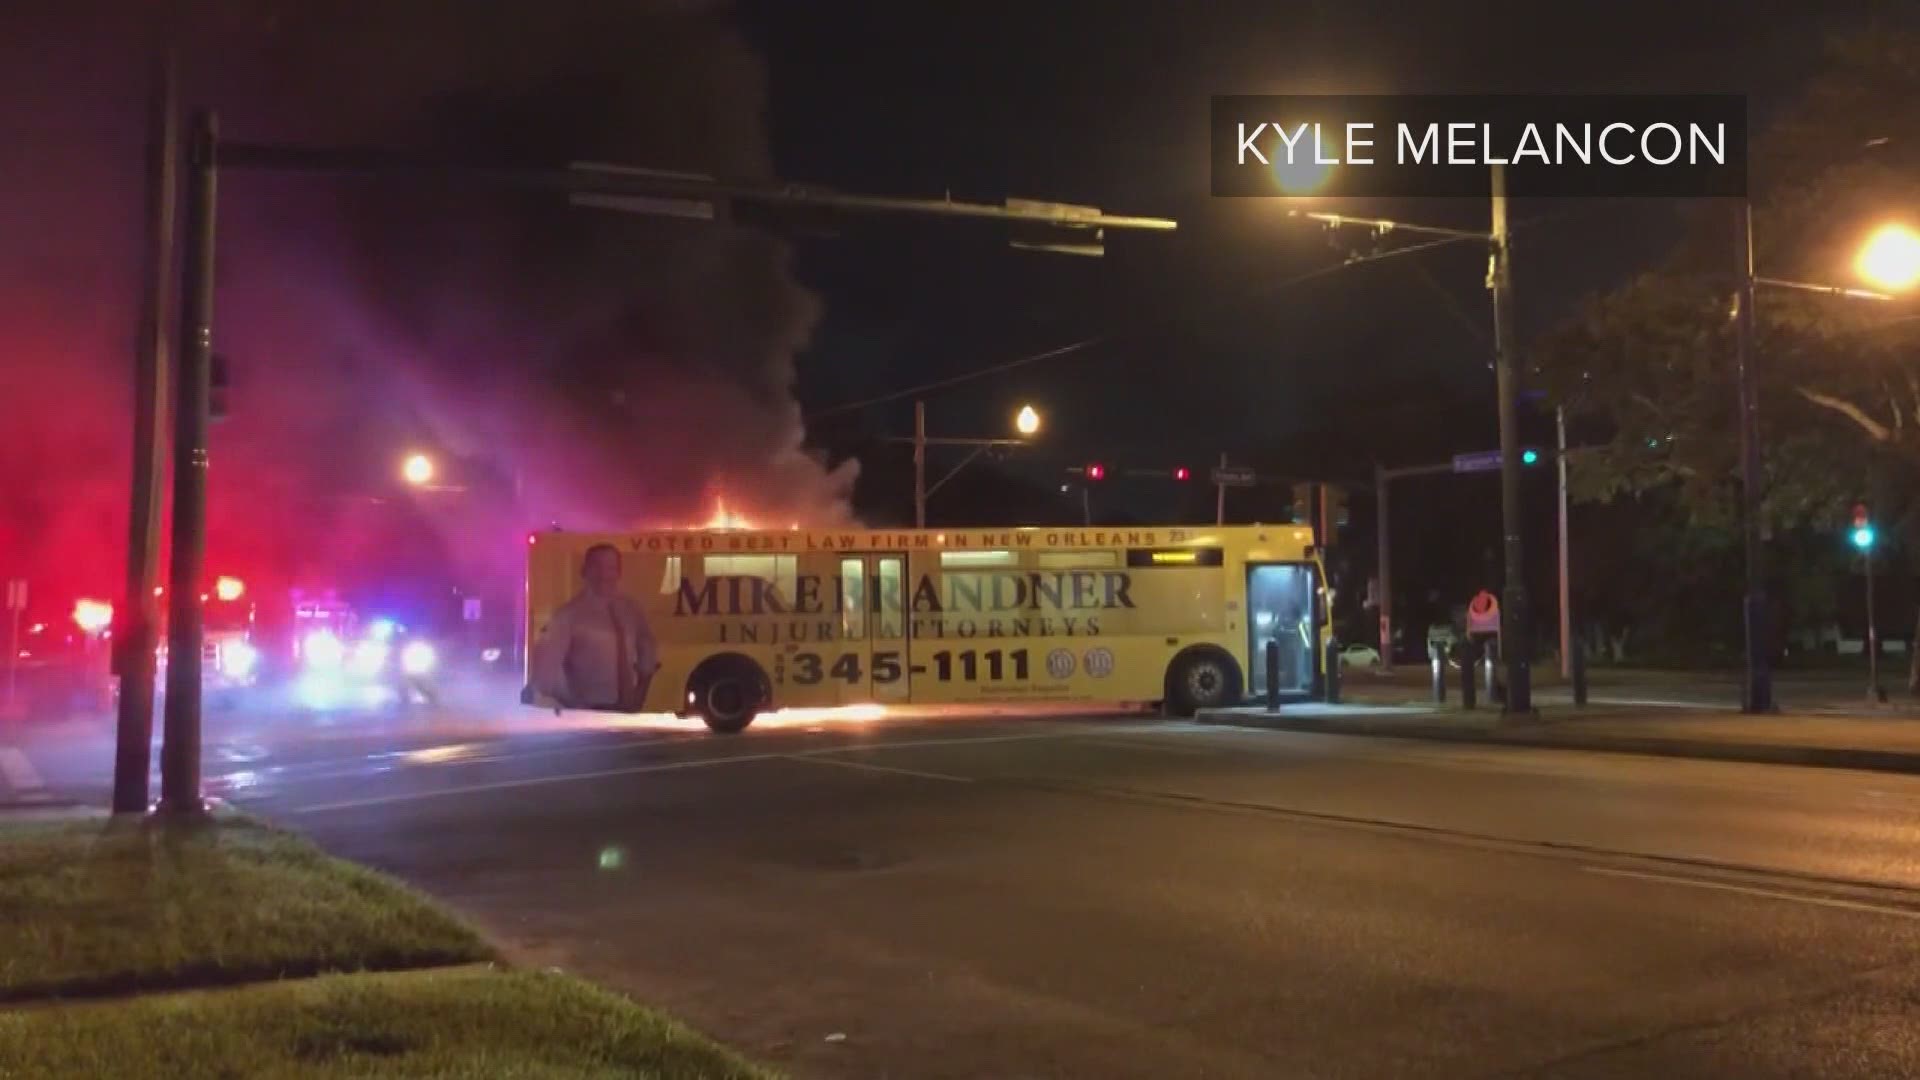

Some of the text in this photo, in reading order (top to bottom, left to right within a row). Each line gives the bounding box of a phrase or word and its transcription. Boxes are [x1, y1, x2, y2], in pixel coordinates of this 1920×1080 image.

[631, 536, 713, 551] VOTED
[806, 533, 856, 549] LAW
[870, 535, 929, 548] FIRM
[983, 534, 1032, 547] NEW
[1046, 532, 1156, 547] ORLEANS
[674, 574, 824, 615] MIKE
[791, 648, 1029, 685] 345-1111
